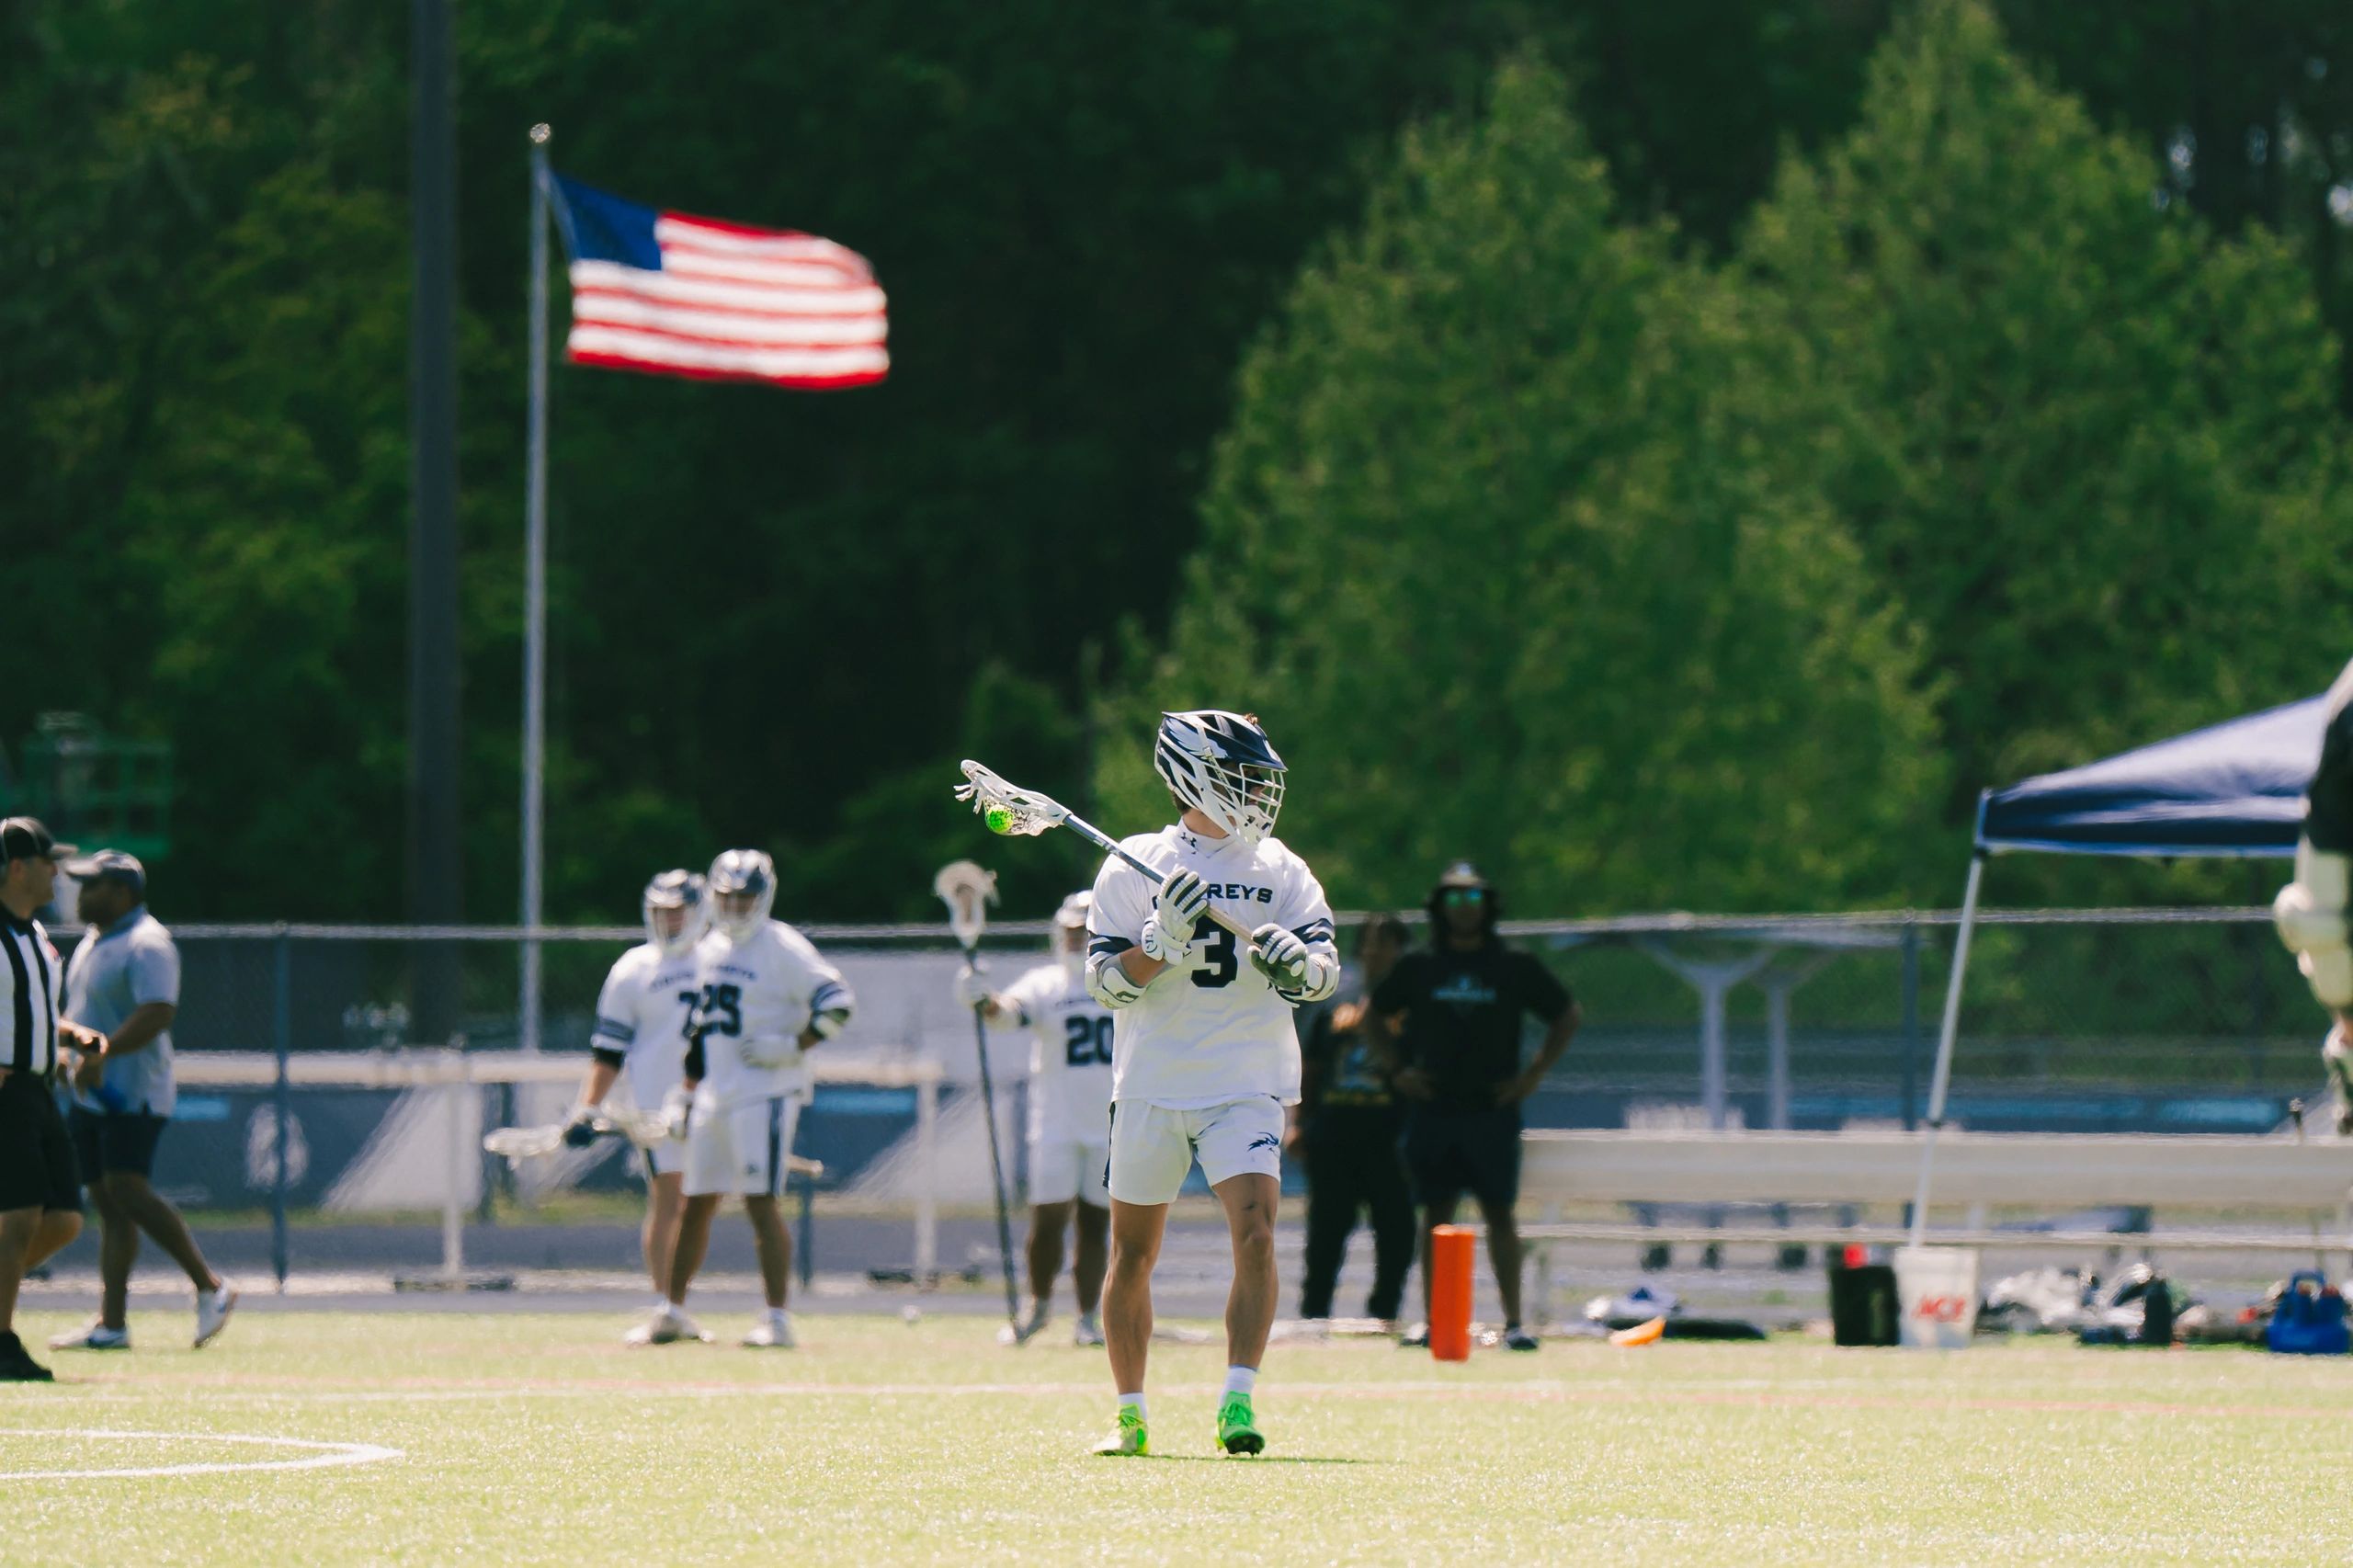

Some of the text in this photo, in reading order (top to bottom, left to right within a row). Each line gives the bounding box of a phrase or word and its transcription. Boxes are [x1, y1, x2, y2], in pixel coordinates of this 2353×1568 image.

[1152, 883, 1273, 910] REYS
[1191, 915, 1238, 988] 3
[1065, 1015, 1113, 1066] 20
